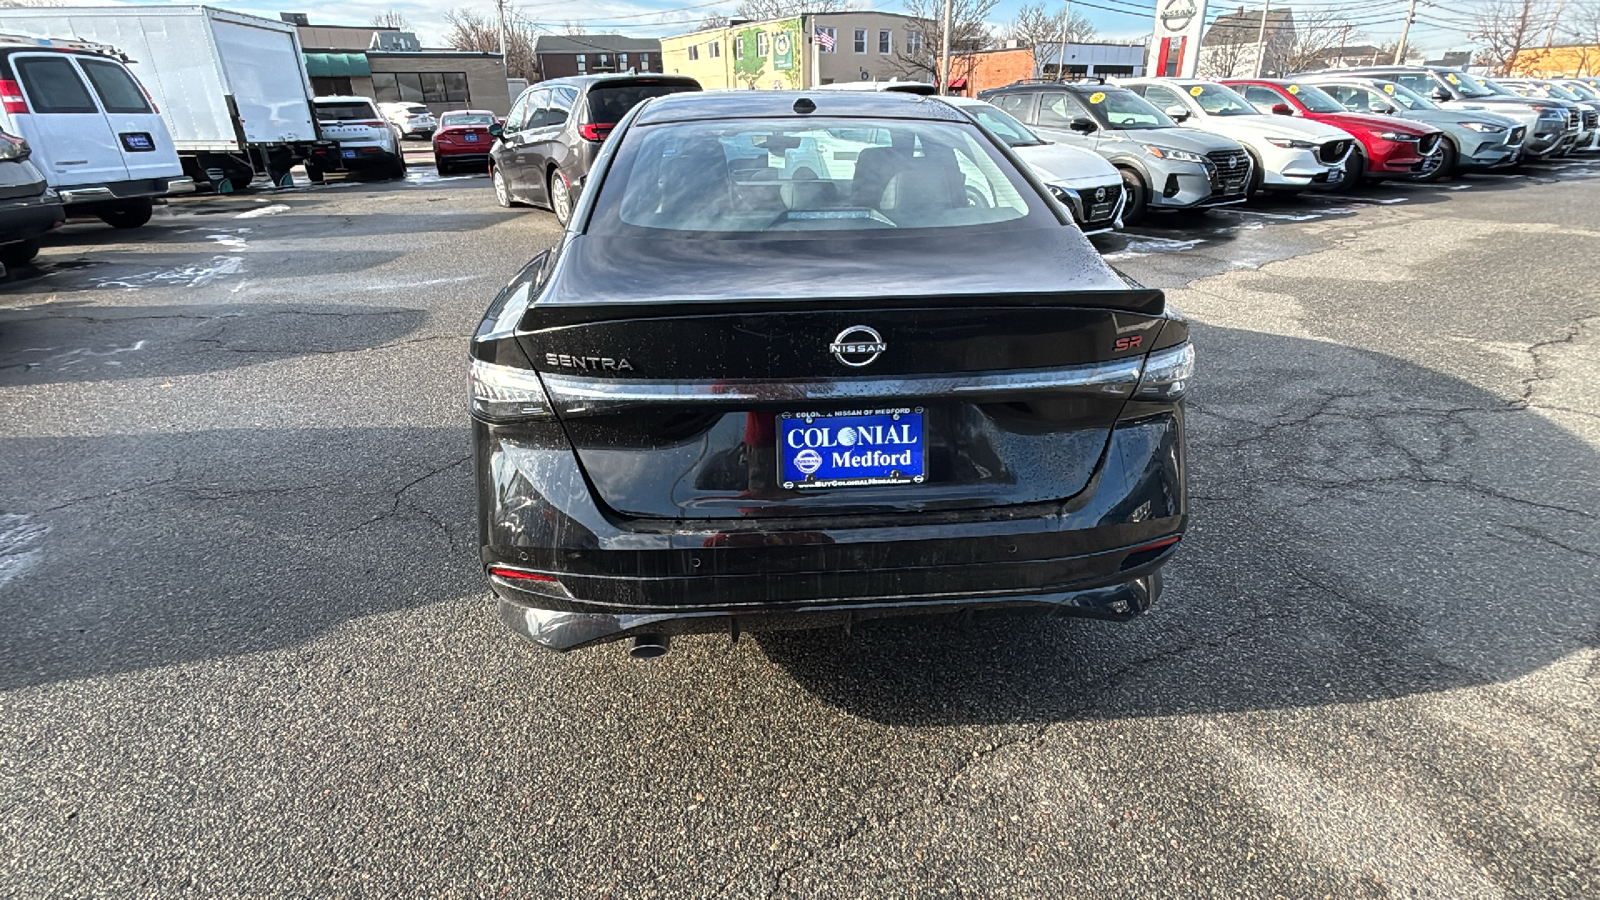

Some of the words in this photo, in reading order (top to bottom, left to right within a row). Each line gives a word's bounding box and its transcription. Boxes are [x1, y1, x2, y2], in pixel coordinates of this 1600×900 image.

[1162, 8, 1193, 17] NISSAN
[831, 344, 887, 353] NISSAN
[1113, 335, 1143, 352] SR
[545, 353, 634, 371] SENTRA
[796, 411, 833, 419] COLONAL
[787, 424, 917, 449] COLONIAL
[832, 450, 911, 468] Medford
